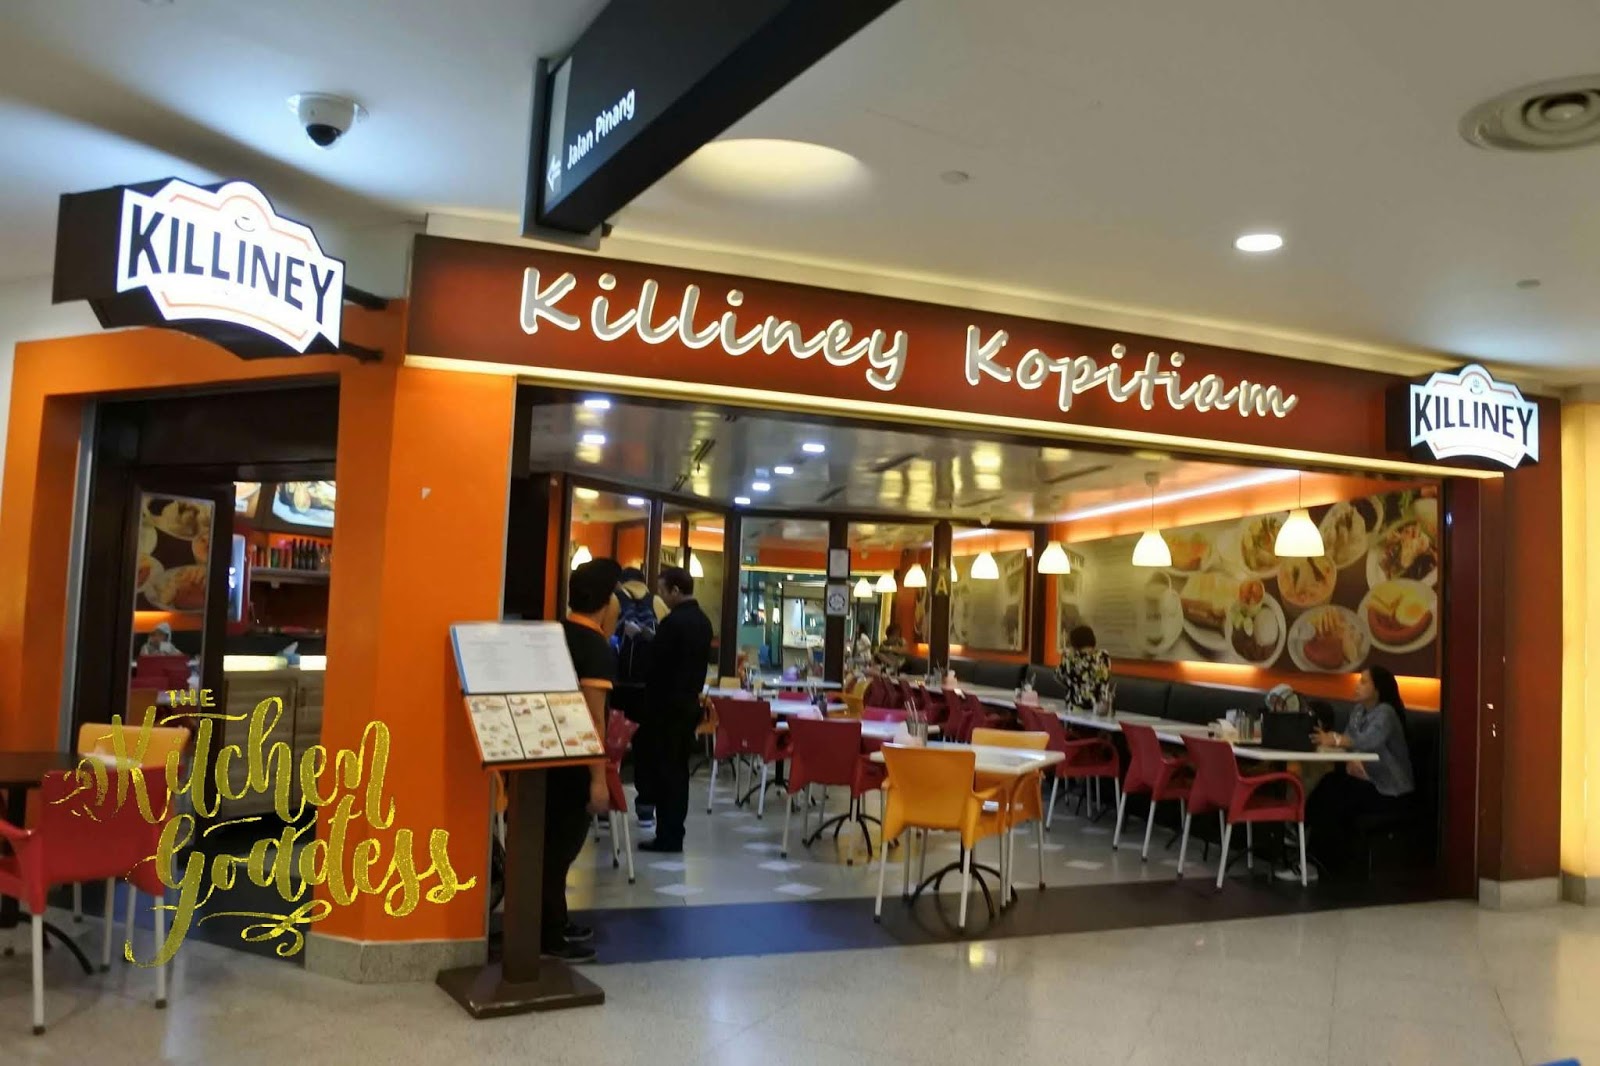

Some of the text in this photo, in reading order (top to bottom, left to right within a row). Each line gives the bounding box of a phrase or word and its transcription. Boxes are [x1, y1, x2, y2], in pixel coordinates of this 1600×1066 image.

[567, 89, 635, 169] Jalan Pinang
[128, 204, 335, 324] KILLINEY
[520, 266, 1299, 417] Killiney Kopitiam
[1415, 392, 1533, 446] KILLINEY
